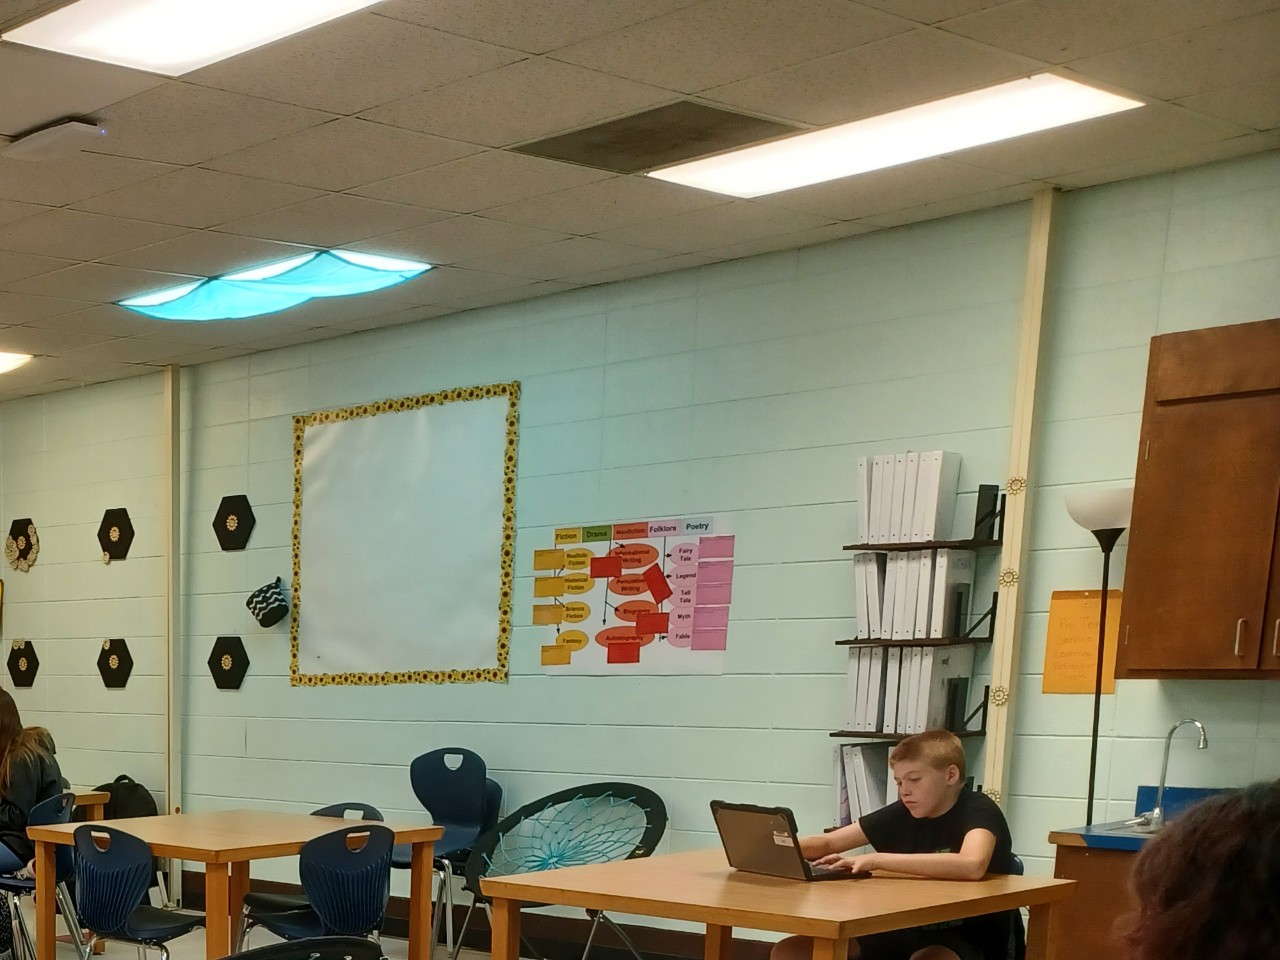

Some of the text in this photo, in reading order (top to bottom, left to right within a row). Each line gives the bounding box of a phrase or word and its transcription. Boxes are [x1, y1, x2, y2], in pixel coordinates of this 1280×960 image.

[649, 524, 677, 534] Folklore
[685, 521, 710, 532] Poetry
[555, 532, 578, 541] Fiction
[586, 530, 608, 539] Drama
[678, 547, 693, 555] Fairy
[676, 572, 697, 580] Legend
